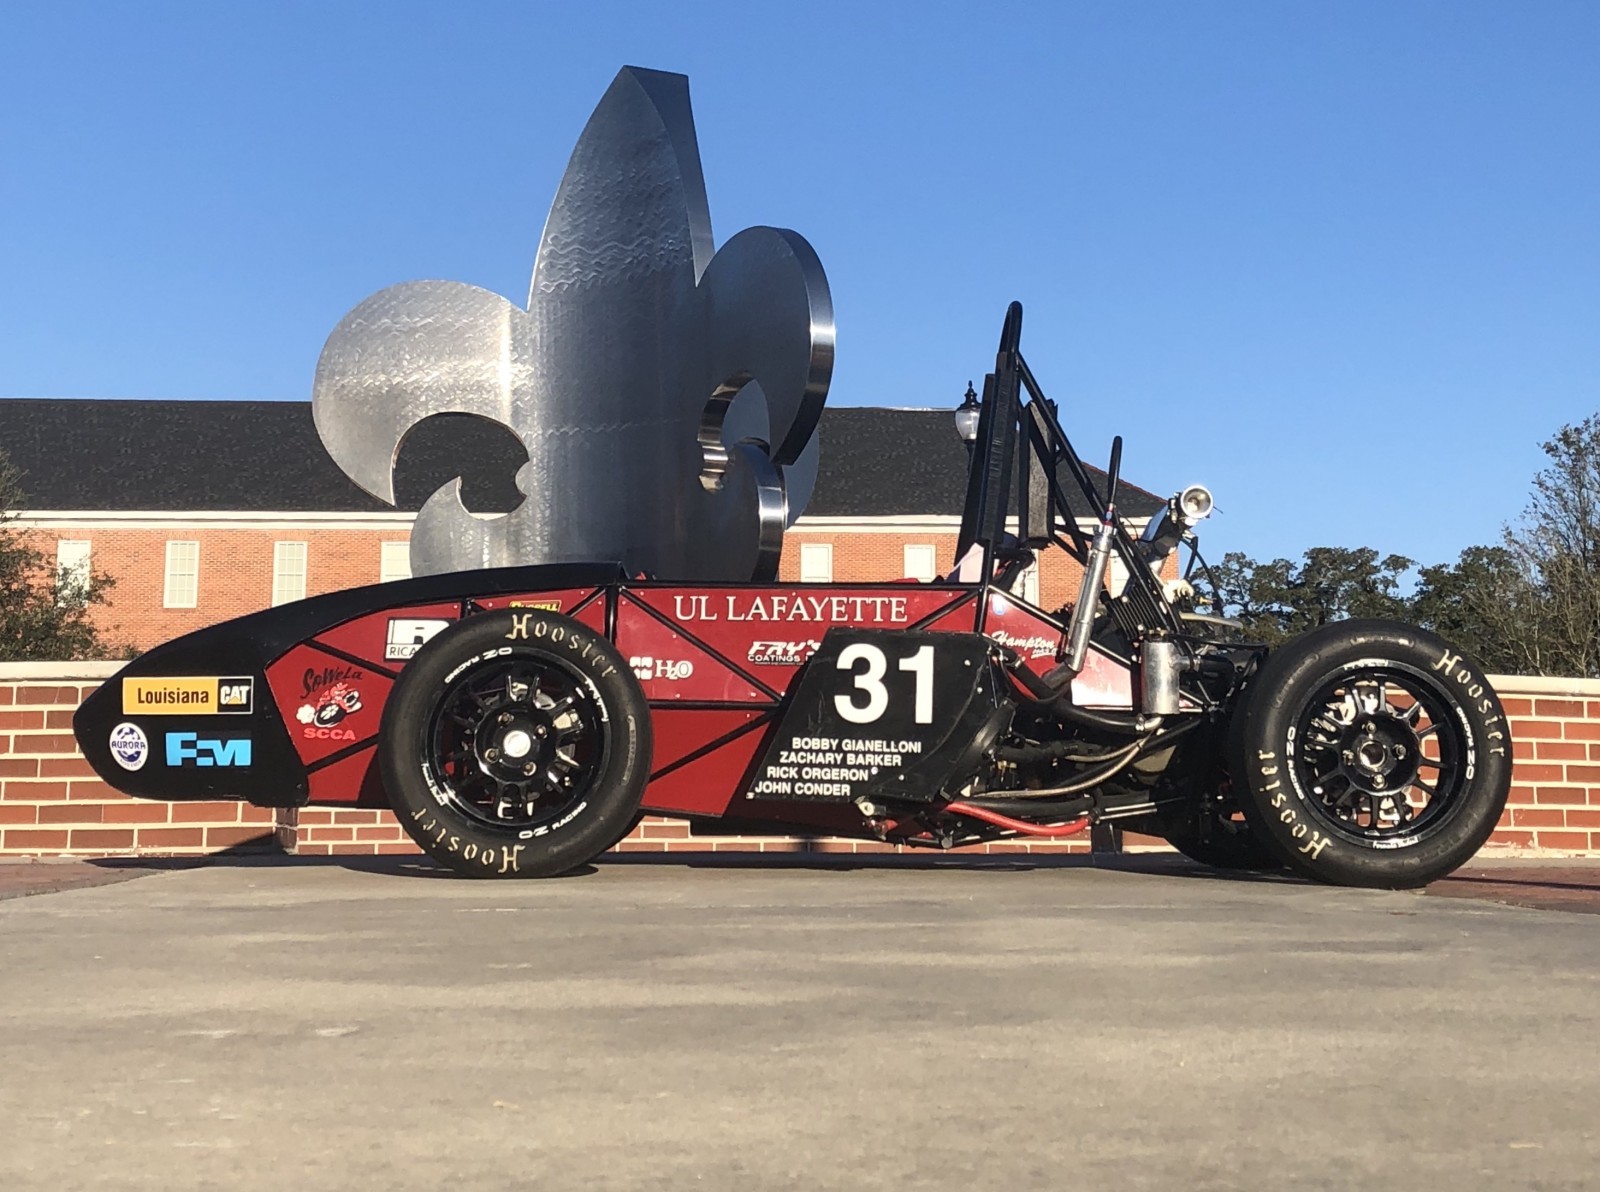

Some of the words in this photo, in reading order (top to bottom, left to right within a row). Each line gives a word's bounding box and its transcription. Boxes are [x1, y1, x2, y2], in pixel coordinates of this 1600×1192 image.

[673, 595, 718, 621] UL
[726, 595, 908, 622] LAFAYETTE
[504, 613, 617, 678] Hoosier
[991, 630, 1055, 651] Hampton
[747, 654, 801, 662] COATINGS
[834, 643, 934, 724] 31
[137, 687, 209, 704] Louisiana
[220, 685, 251, 705] CAT
[1430, 648, 1505, 758] Hoosier
[303, 727, 356, 740] SCCA
[111, 740, 146, 750] AURORA
[792, 737, 839, 750] BOBBY
[841, 738, 922, 753] GIANELLONI
[779, 751, 843, 765] ZACHARY
[846, 753, 902, 767] BARKER
[766, 766, 799, 779] RICK
[801, 767, 869, 781] ORGERON
[754, 781, 792, 794] JOHN
[794, 782, 851, 796] CONDER
[1257, 749, 1334, 861] Hoosier
[410, 806, 526, 874] Hoosier
